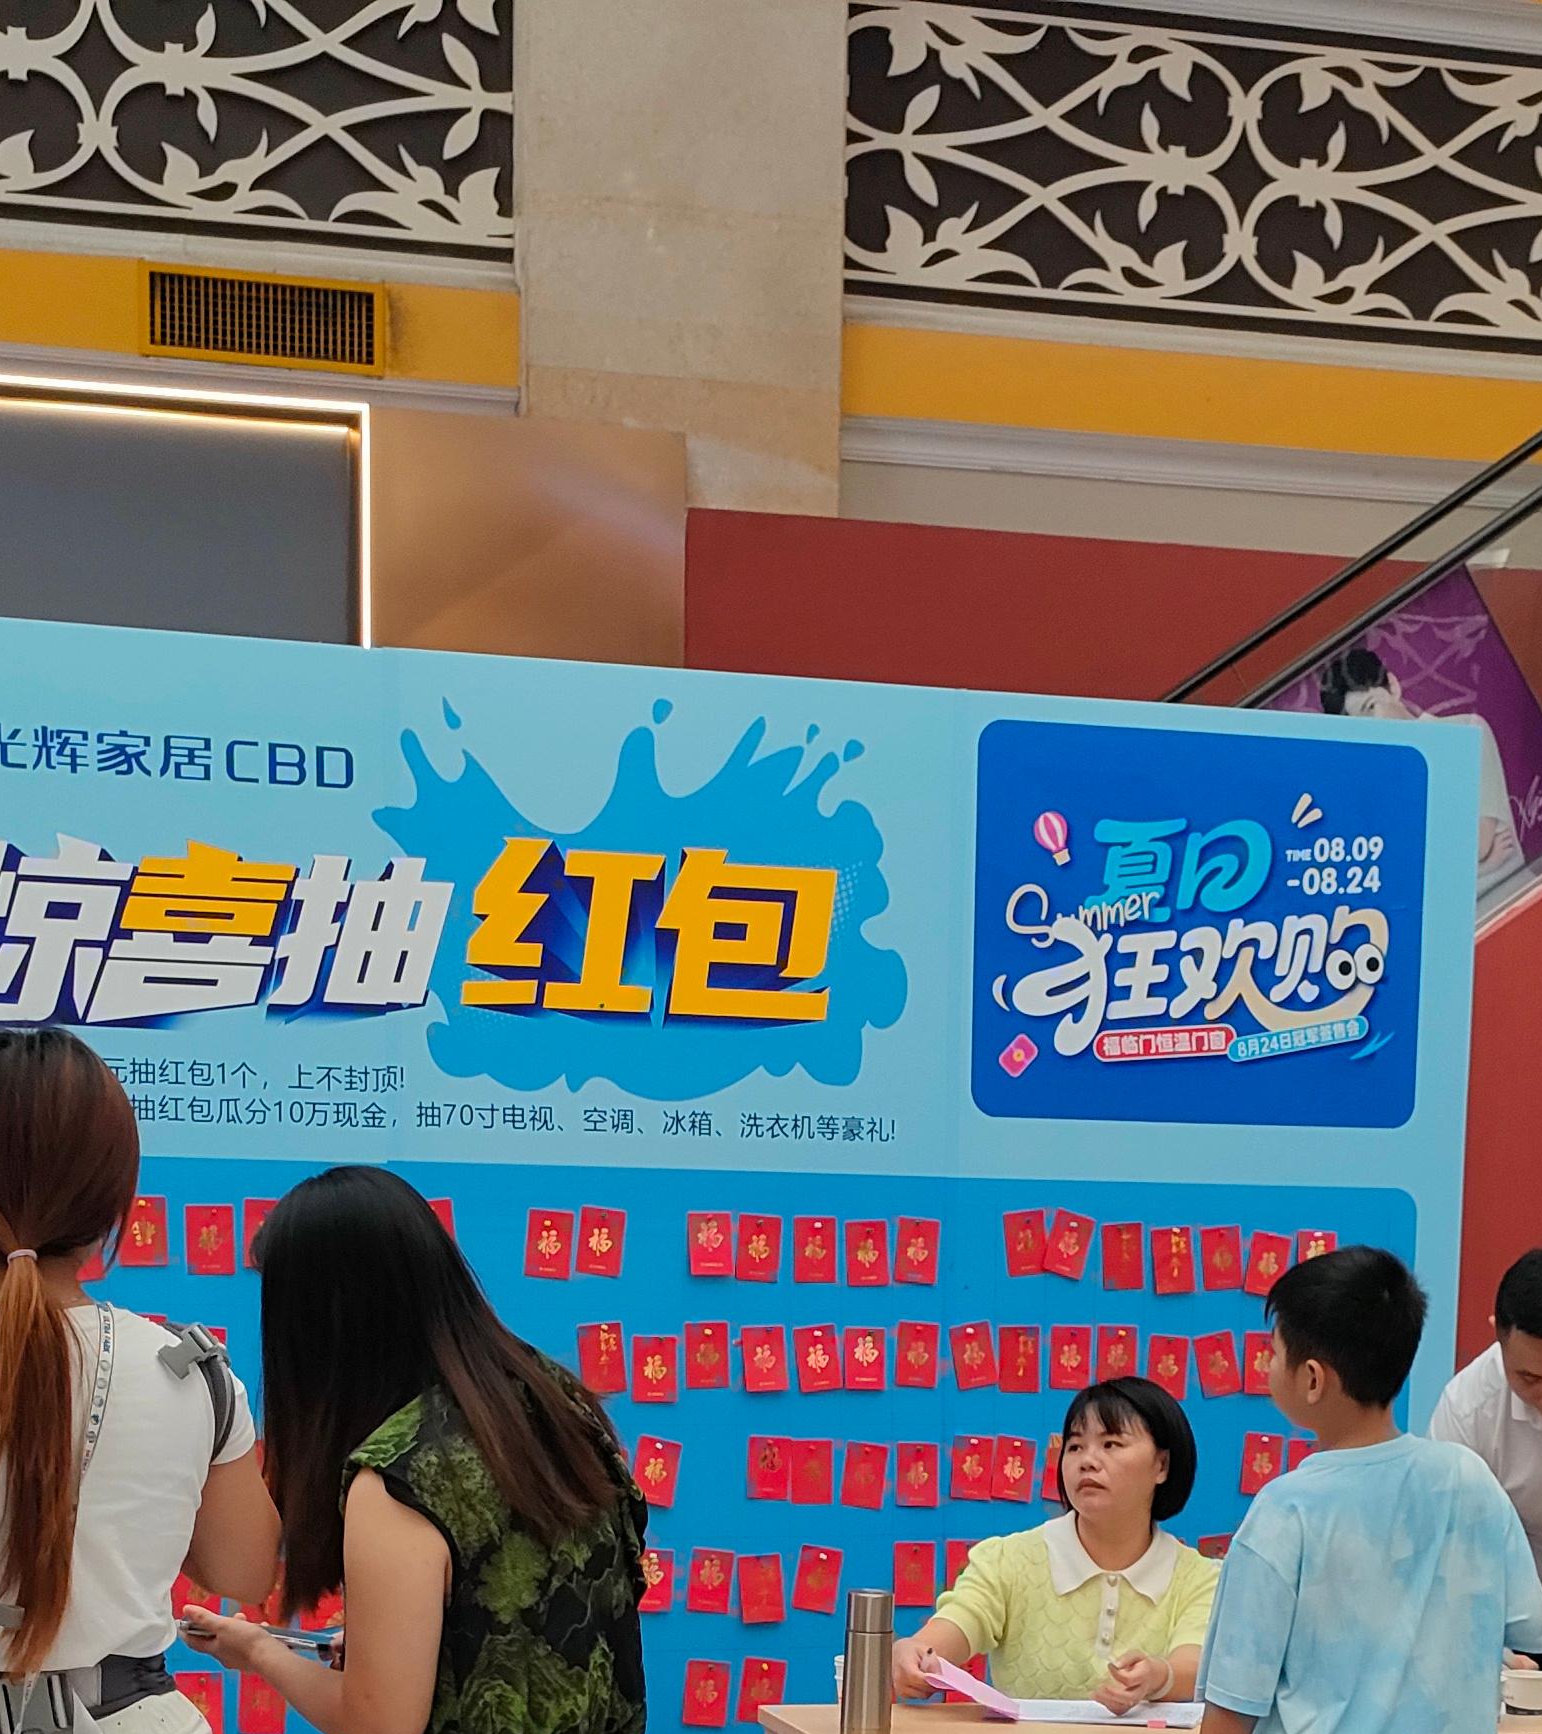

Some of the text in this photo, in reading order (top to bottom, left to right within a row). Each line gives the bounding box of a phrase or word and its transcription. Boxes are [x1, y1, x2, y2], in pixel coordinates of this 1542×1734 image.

[1286, 836, 1384, 862] TIME 08.09
[1287, 867, 1381, 894] -08.24
[1006, 884, 1160, 948] Smmer
[1102, 1030, 1227, 1055] 福临门恒温门窗
[537, 1228, 562, 1260] 福
[588, 1227, 612, 1257] 福
[748, 1234, 770, 1262] 福
[806, 1344, 829, 1373] 福
[854, 1336, 879, 1367] 福
[643, 1354, 667, 1384] 福
[1004, 1455, 1025, 1483] 福
